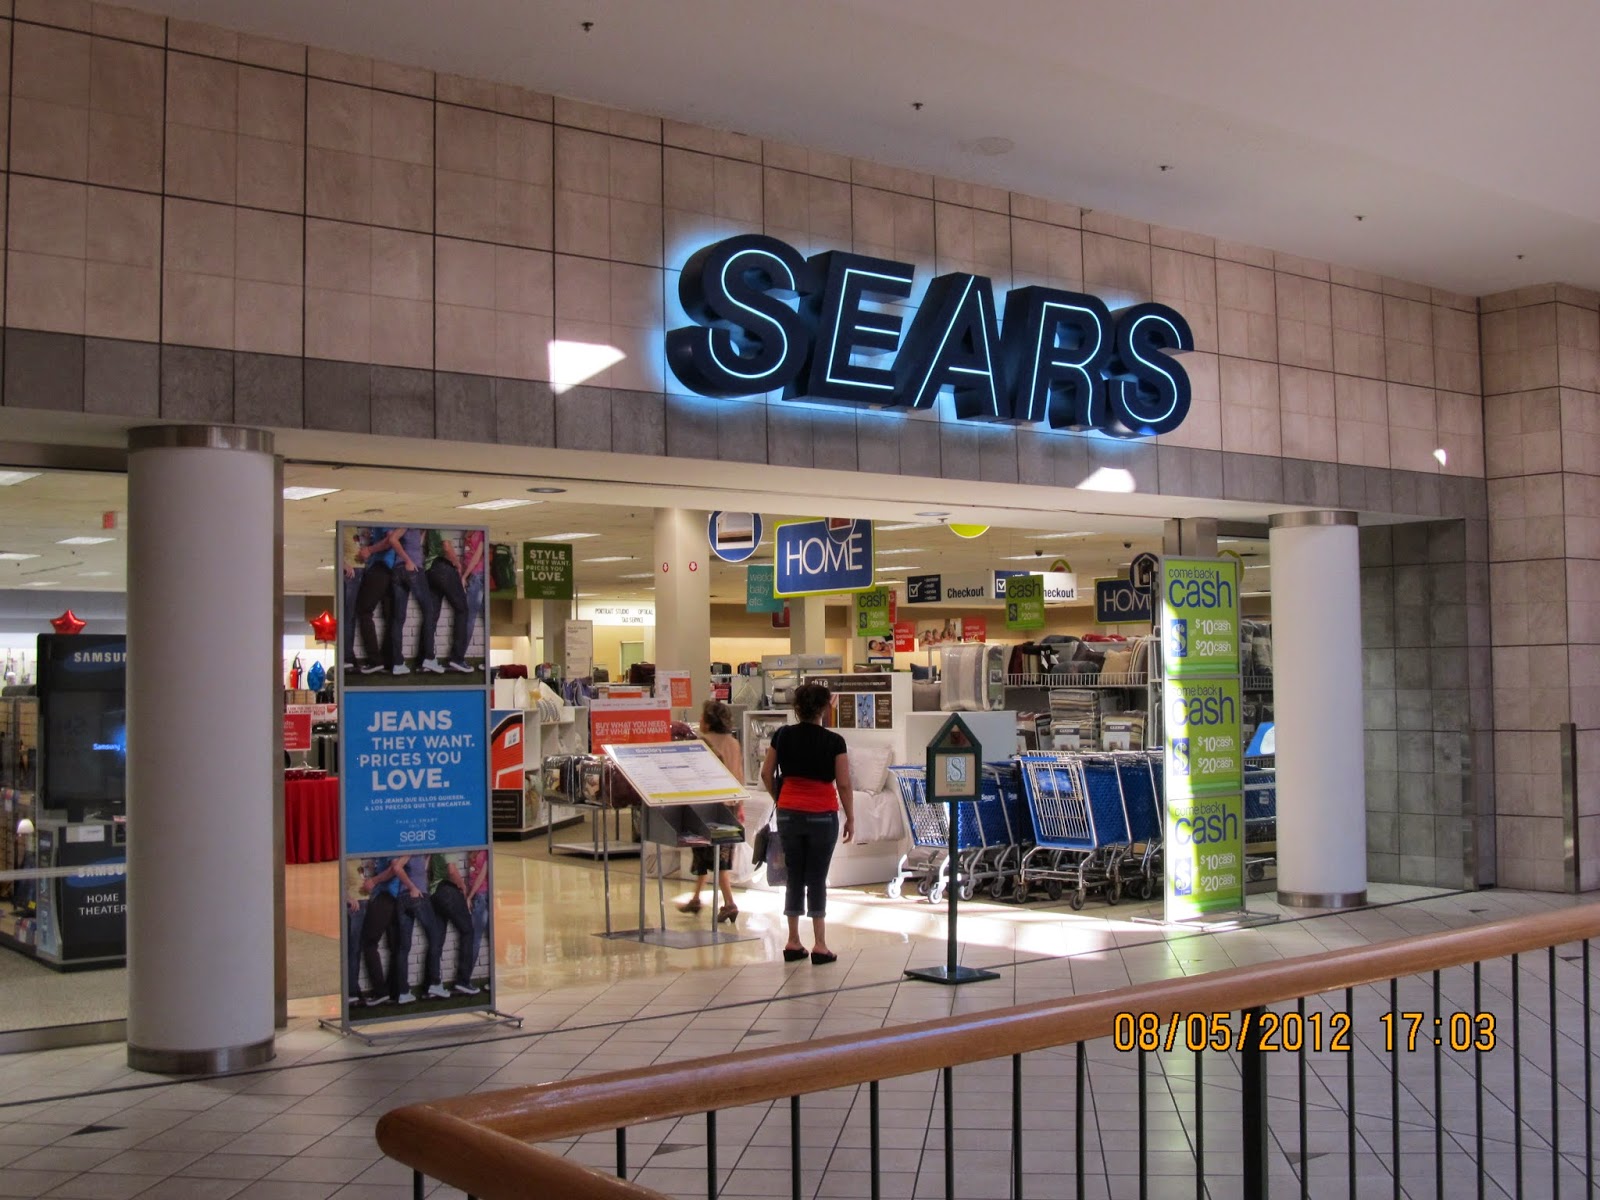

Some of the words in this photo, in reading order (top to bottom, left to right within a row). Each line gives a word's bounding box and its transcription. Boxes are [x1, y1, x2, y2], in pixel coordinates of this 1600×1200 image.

[666, 233, 1194, 438] SEARS
[530, 549, 566, 560] STYLE
[786, 533, 863, 576] HOME
[531, 571, 565, 582] LOVE.
[750, 573, 773, 581] wedd
[1168, 568, 1193, 579] come
[1194, 566, 1215, 579] back
[750, 584, 770, 595] baby
[947, 586, 984, 599] Checkout
[1008, 578, 1041, 599] cash
[1044, 587, 1074, 598] eckout
[1168, 570, 1232, 608] cash
[859, 590, 887, 608] cash
[1103, 588, 1150, 612] HOM
[1195, 619, 1213, 635] $10
[1213, 620, 1231, 631] cash
[1195, 640, 1214, 656] $20
[1213, 641, 1231, 652] cash
[74, 652, 127, 663] SAMSU
[1197, 684, 1217, 696] back
[1172, 687, 1235, 726] cash
[367, 709, 453, 732] JEANS
[610, 721, 631, 729] WHAT
[632, 720, 647, 728] YOU
[595, 728, 610, 736] GET
[632, 727, 647, 735] YOU
[93, 743, 121, 751] Samsung
[371, 736, 417, 750] THEY
[423, 734, 475, 749] WANT.
[1198, 736, 1216, 752] $10
[1215, 736, 1233, 747] cash
[360, 752, 422, 767] PRICES
[426, 751, 461, 765] YOU
[1198, 757, 1216, 773] $20
[1215, 757, 1234, 768] cash
[372, 768, 450, 791] LOVE.
[981, 793, 996, 802] Sears
[1175, 806, 1199, 816] come
[1200, 801, 1220, 815] back
[1175, 803, 1238, 845] cash
[399, 829, 436, 842] sears
[1200, 854, 1219, 870] $10
[1218, 853, 1236, 864] cash
[78, 864, 124, 878] SAMSU
[1200, 875, 1219, 891] $20
[1218, 874, 1236, 885] cash
[86, 893, 119, 903] HOME
[78, 904, 128, 916] THEATER
